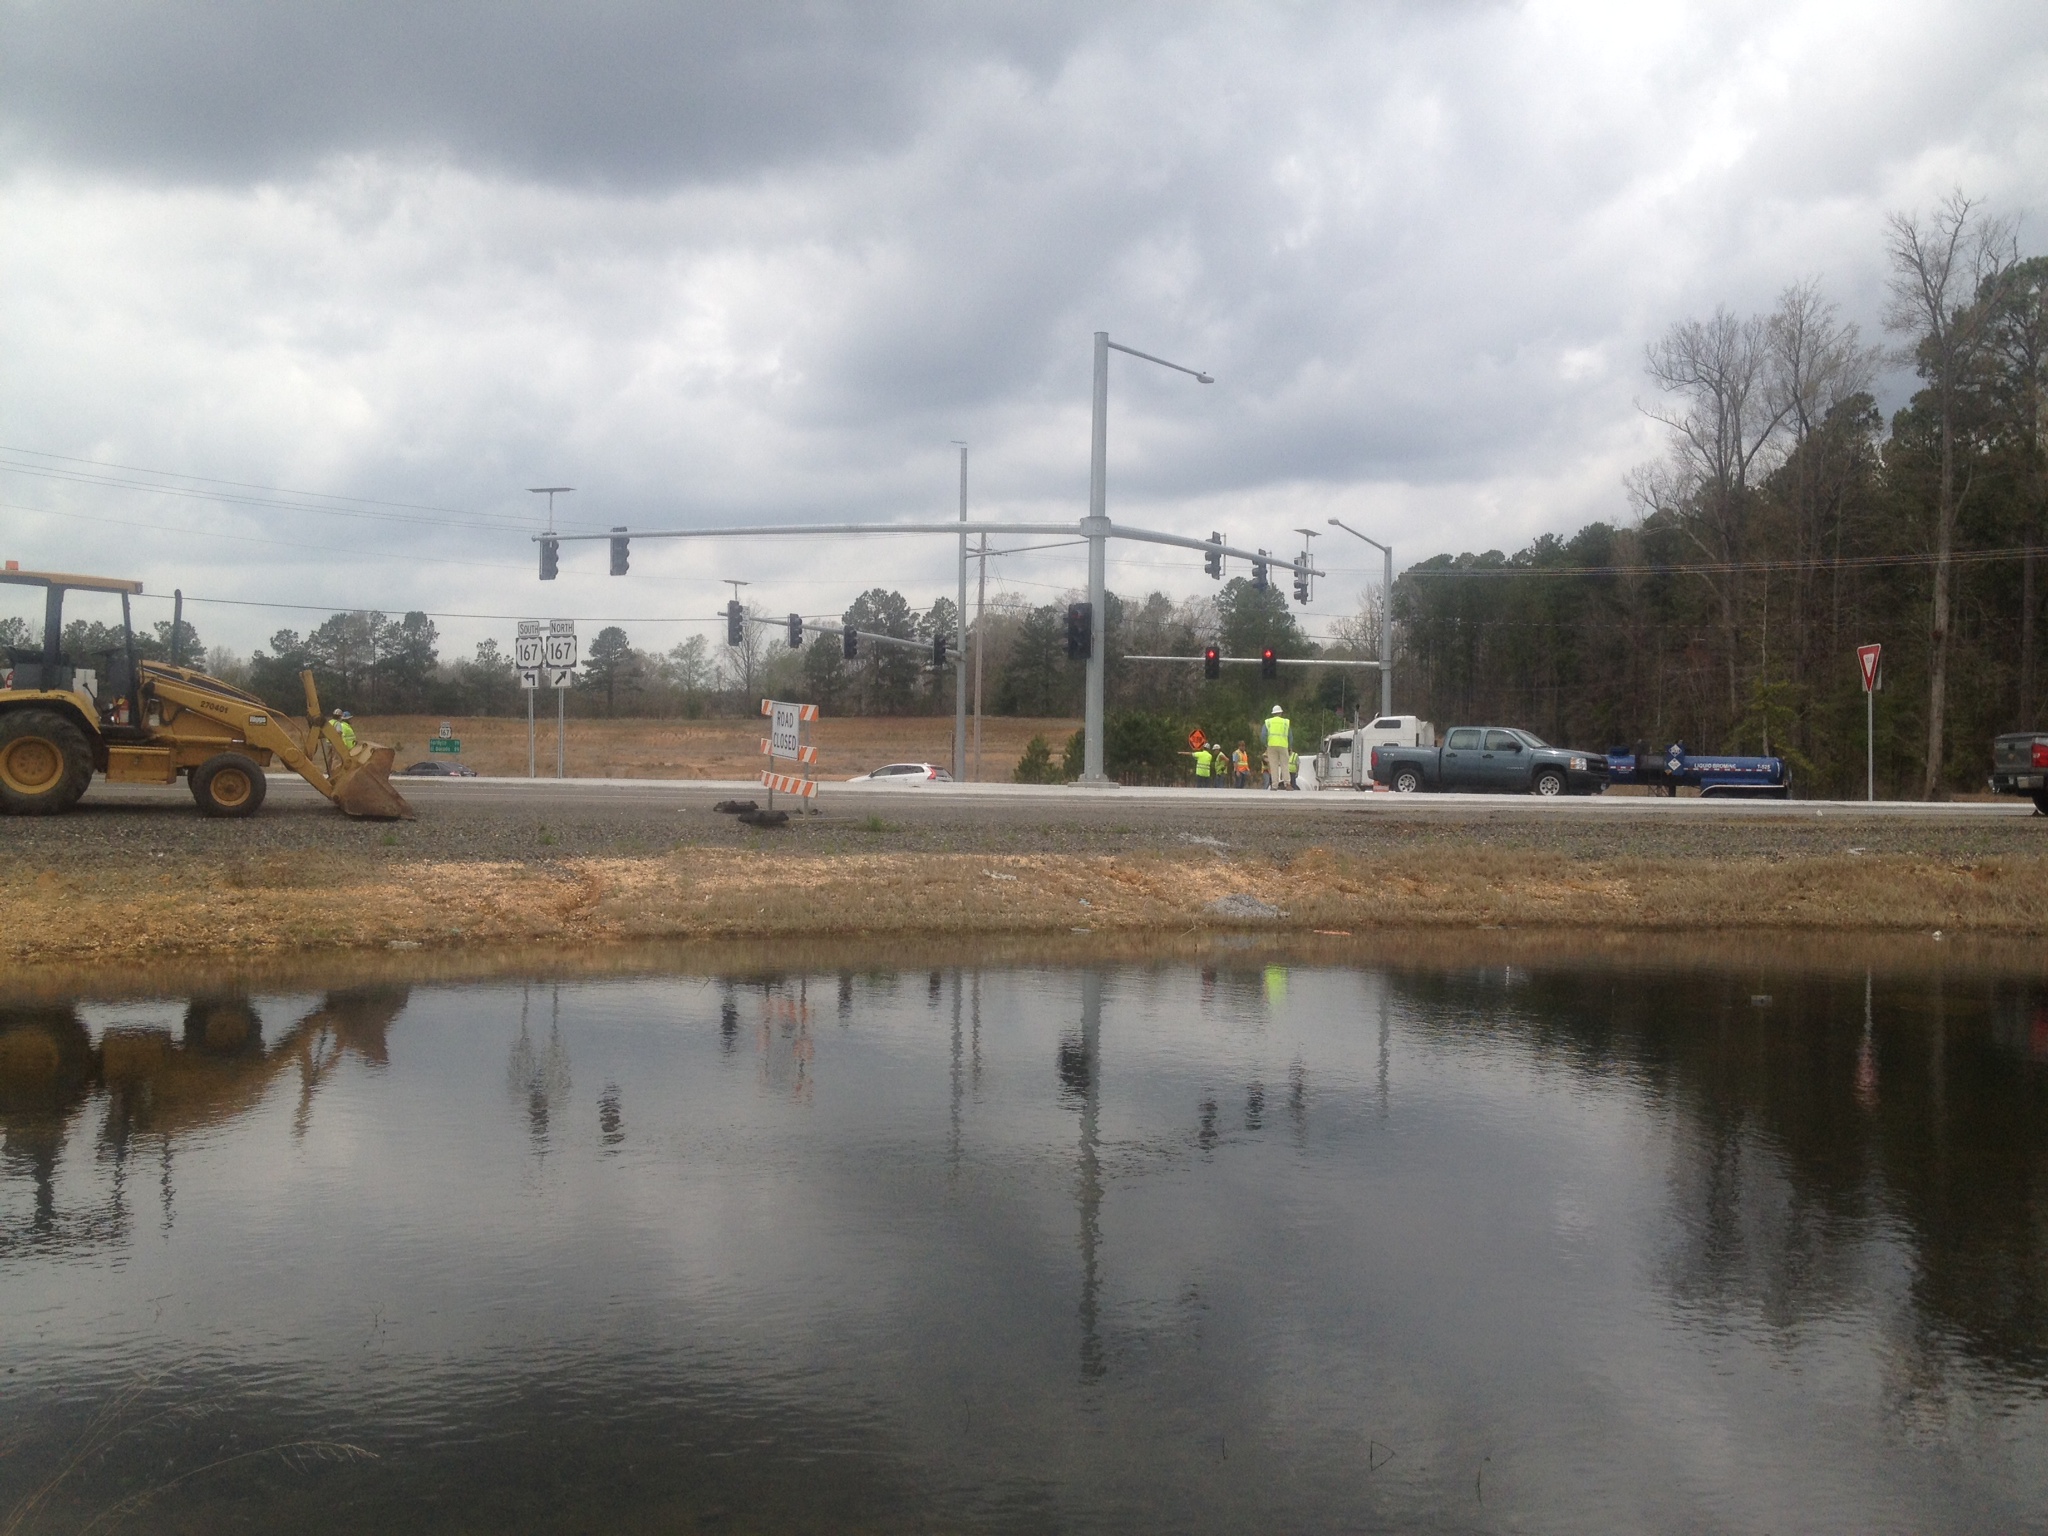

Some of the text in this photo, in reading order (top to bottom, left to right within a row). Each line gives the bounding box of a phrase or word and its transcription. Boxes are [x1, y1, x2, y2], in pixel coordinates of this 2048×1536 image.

[520, 624, 538, 634] SOUTH
[552, 623, 572, 632] NORTH
[520, 644, 538, 660] 167
[551, 642, 571, 660] 167
[777, 711, 794, 728] ROAD
[774, 732, 796, 750] CLOSED
